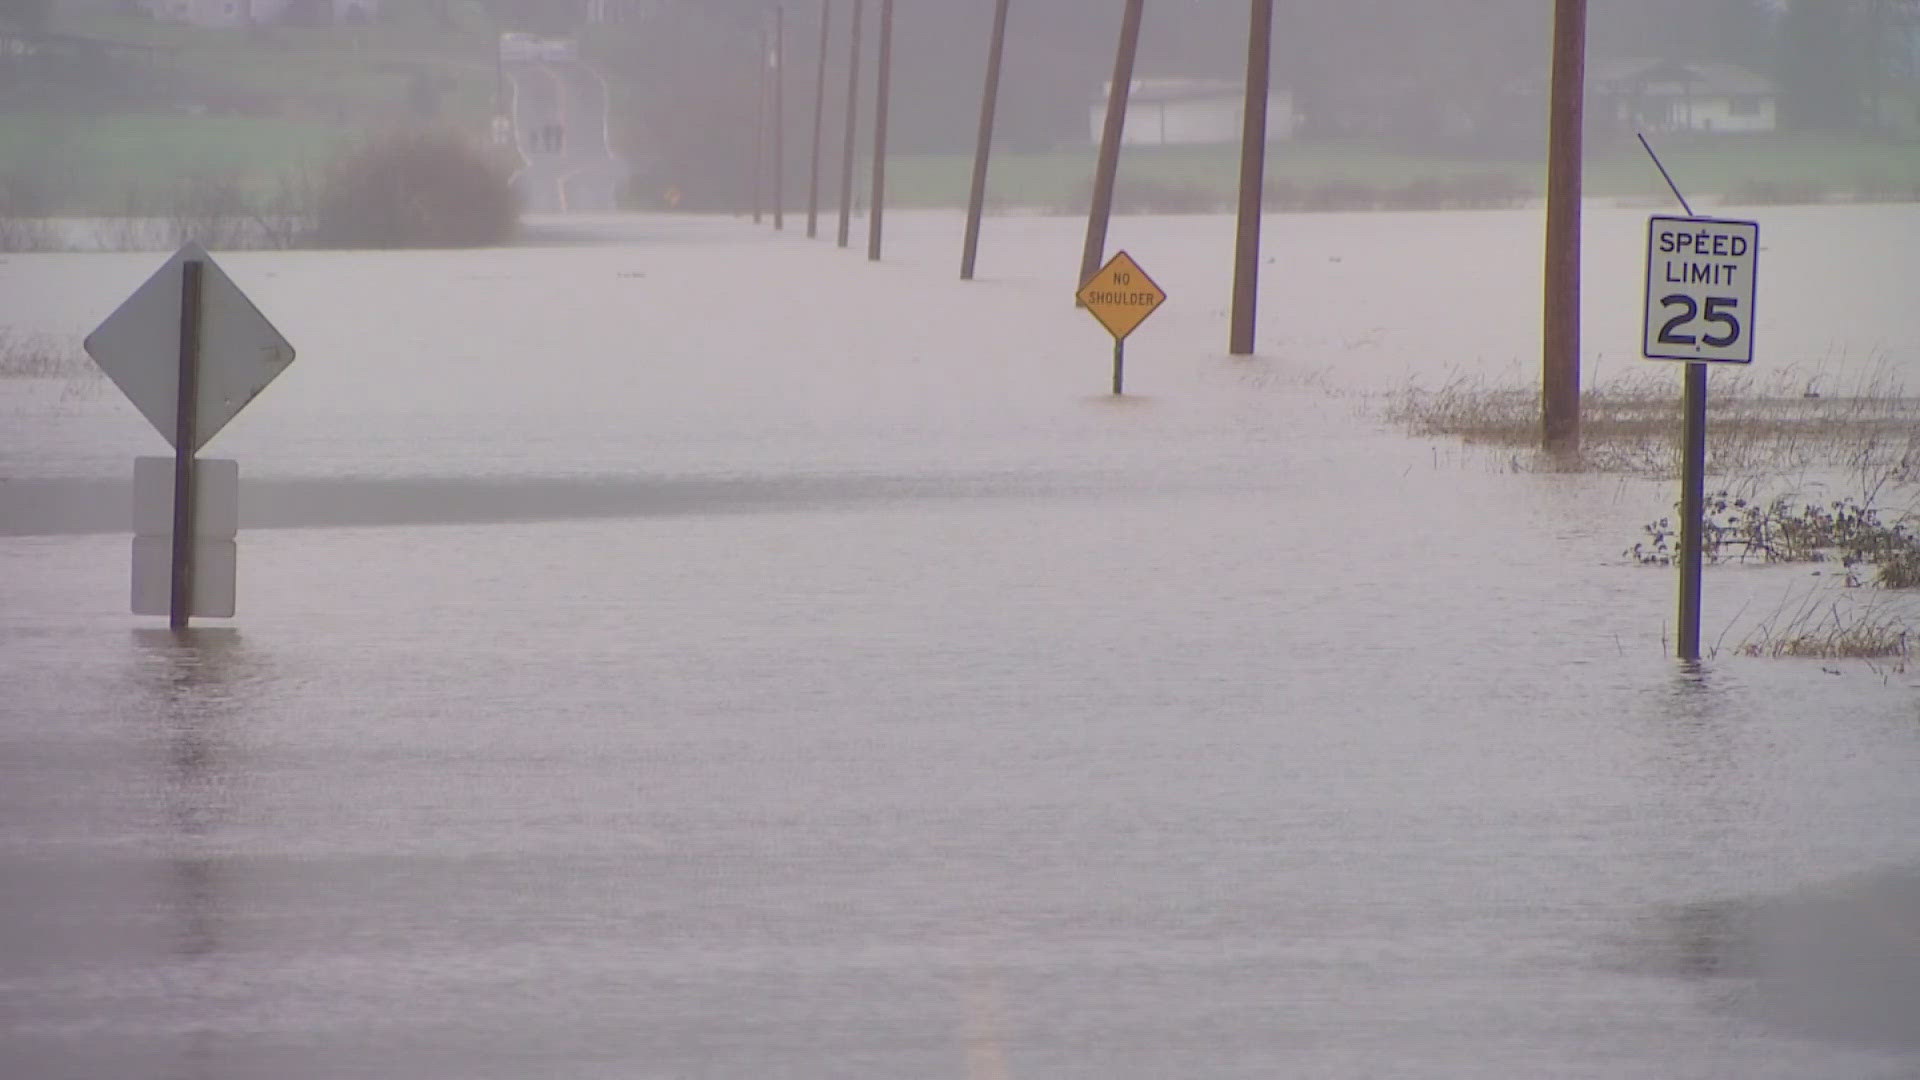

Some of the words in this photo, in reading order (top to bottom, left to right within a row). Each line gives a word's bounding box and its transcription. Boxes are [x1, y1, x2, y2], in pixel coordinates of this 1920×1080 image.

[1660, 231, 1748, 257] SPEED
[1113, 272, 1130, 286] NO
[1666, 261, 1737, 286] LIMIT
[1088, 290, 1154, 306] SHOULDER
[1658, 293, 1741, 348] 25
